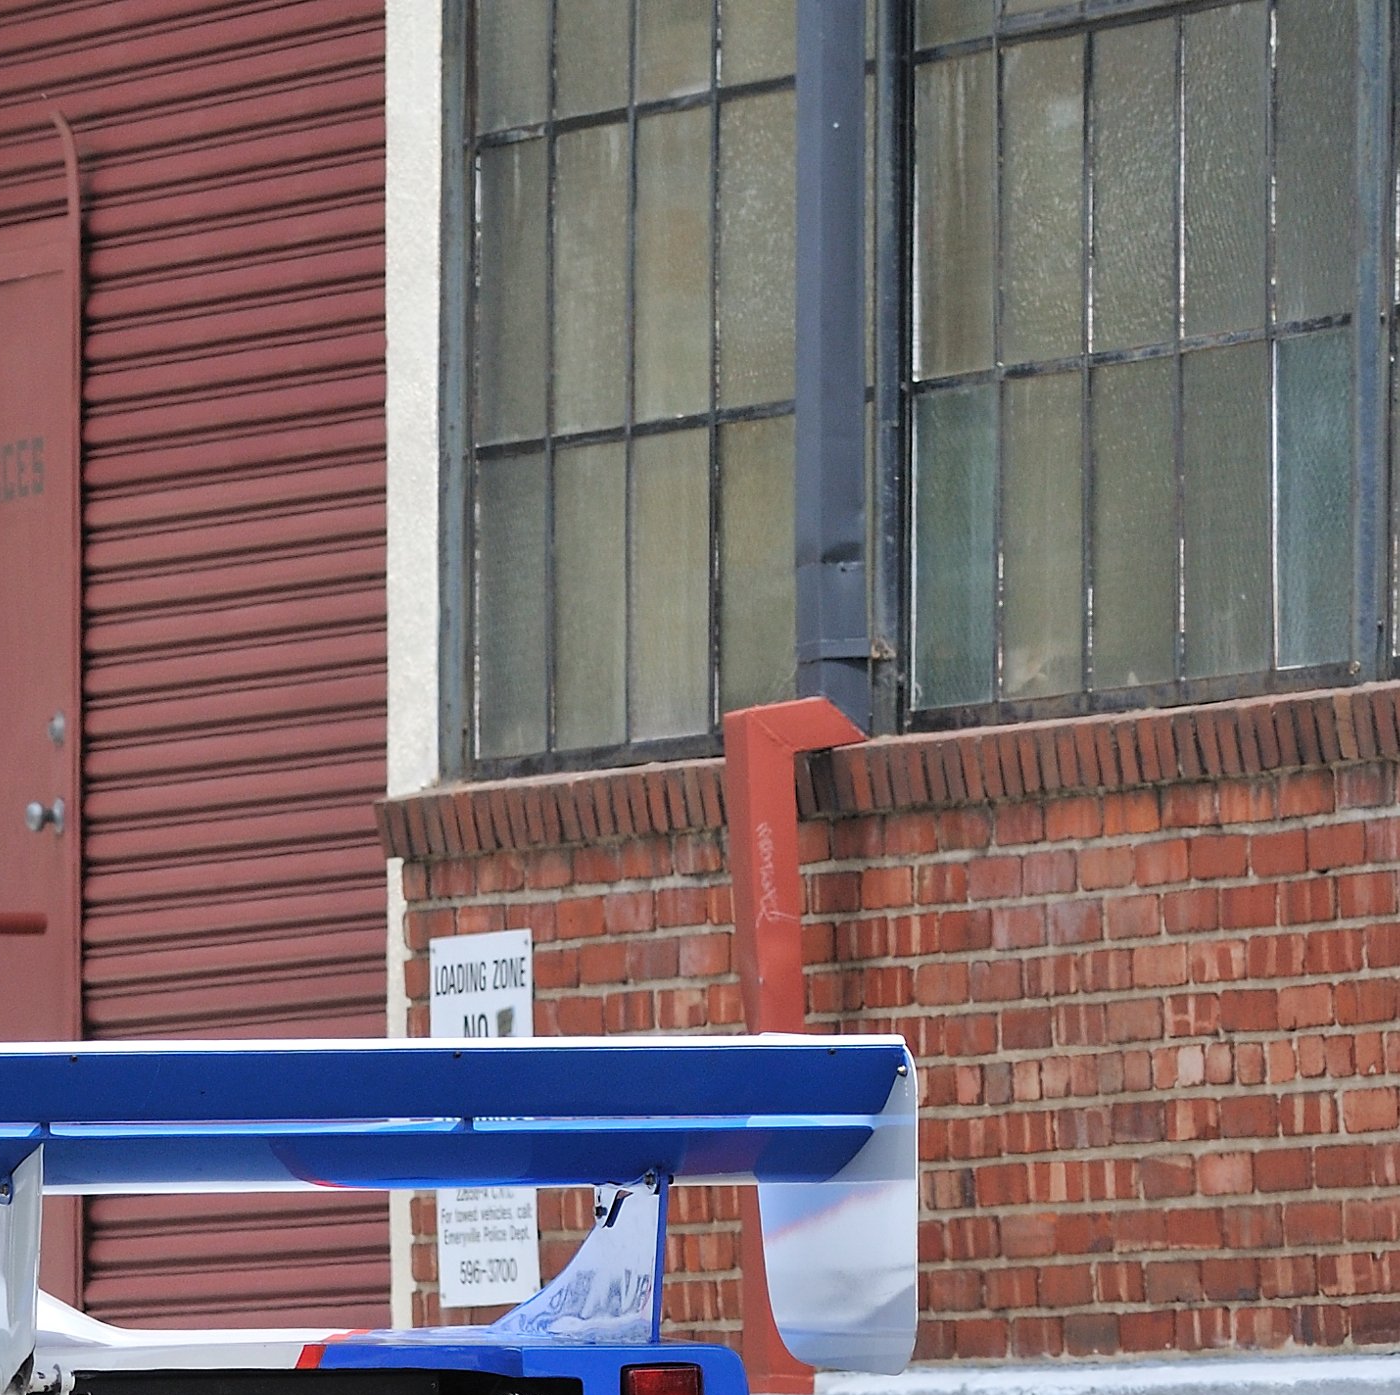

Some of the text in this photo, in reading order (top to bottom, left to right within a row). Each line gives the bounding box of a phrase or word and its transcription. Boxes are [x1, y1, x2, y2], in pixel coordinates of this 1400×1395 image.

[435, 956, 526, 996] LOADING ZONE
[464, 1013, 489, 1038] NO
[460, 1257, 518, 1285] 596-3700
